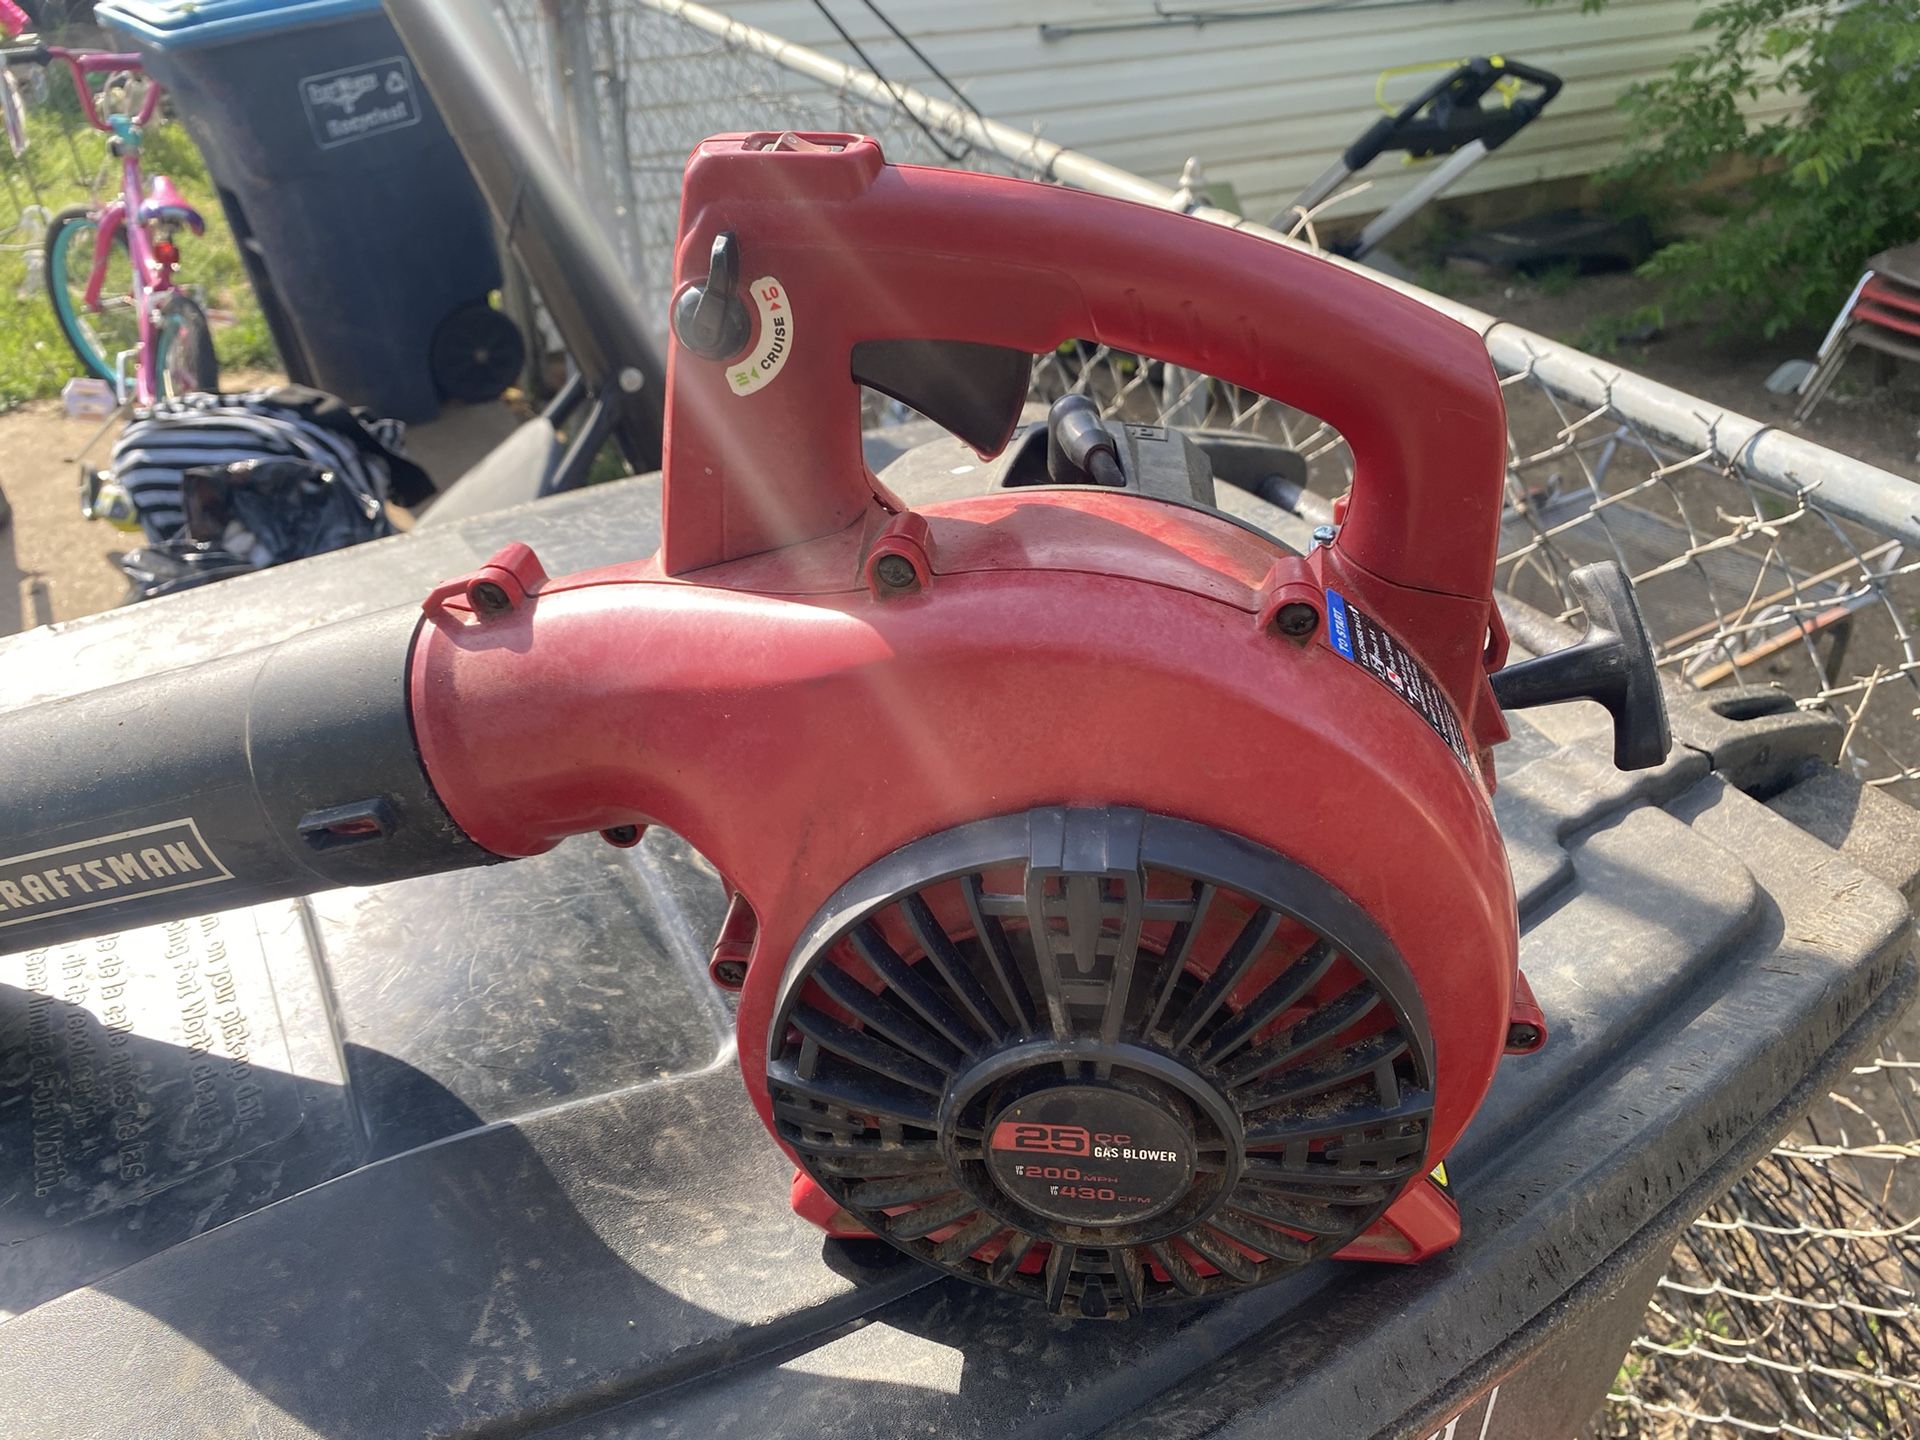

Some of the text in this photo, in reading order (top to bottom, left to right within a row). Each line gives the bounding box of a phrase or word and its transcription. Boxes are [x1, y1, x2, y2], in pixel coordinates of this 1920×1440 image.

[761, 286, 779, 301] LO
[761, 317, 786, 370] CRUISE
[735, 372, 750, 386] HI
[1333, 607, 1350, 653] TO START
[0, 841, 203, 912] RAFTSMAN
[100, 980, 128, 1000] la
[173, 959, 202, 1000] Fort
[204, 962, 238, 1005] your
[102, 1003, 134, 1048] calle
[180, 996, 214, 1062] Worth
[30, 1072, 61, 1120] Fort
[109, 1051, 139, 1108] antes
[115, 1110, 143, 1141] de
[1015, 1126, 1085, 1151] 25
[119, 1141, 147, 1180] las
[1025, 1165, 1120, 1183] 200 MPH
[1094, 1147, 1177, 1162] GAS BLOWER
[1060, 1186, 1151, 1204] 430 CFM
